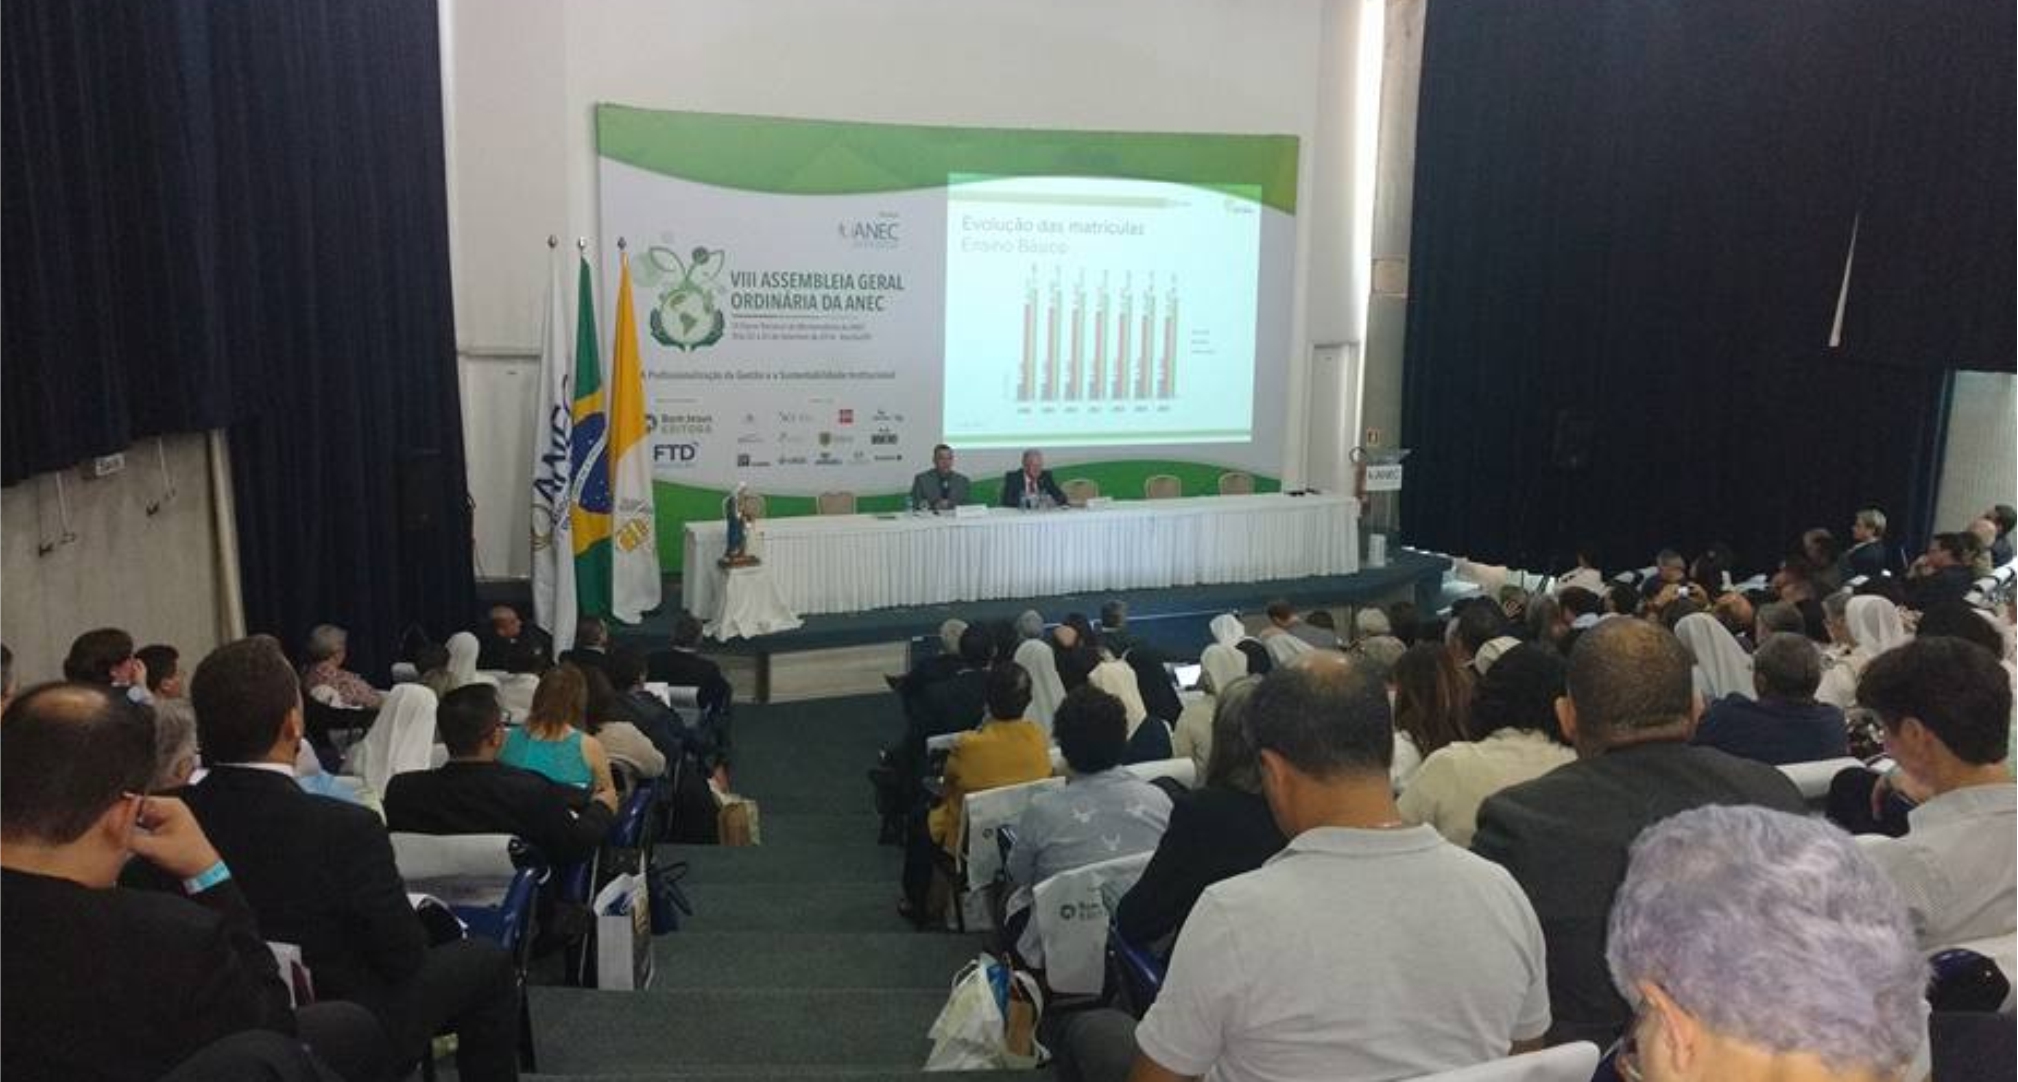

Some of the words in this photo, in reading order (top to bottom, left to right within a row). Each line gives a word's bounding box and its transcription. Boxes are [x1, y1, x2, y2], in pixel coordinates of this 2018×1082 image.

[854, 221, 900, 241] ANEC
[961, 215, 1033, 233] Evolução
[1037, 219, 1064, 234] das
[961, 236, 1014, 253] Ensino
[730, 270, 757, 288] VIII
[761, 271, 854, 290] ASSEMBLEIA
[858, 273, 905, 291] GERAL
[822, 295, 842, 311] DA
[845, 295, 886, 312] ANEC
[654, 444, 696, 462] FTD
